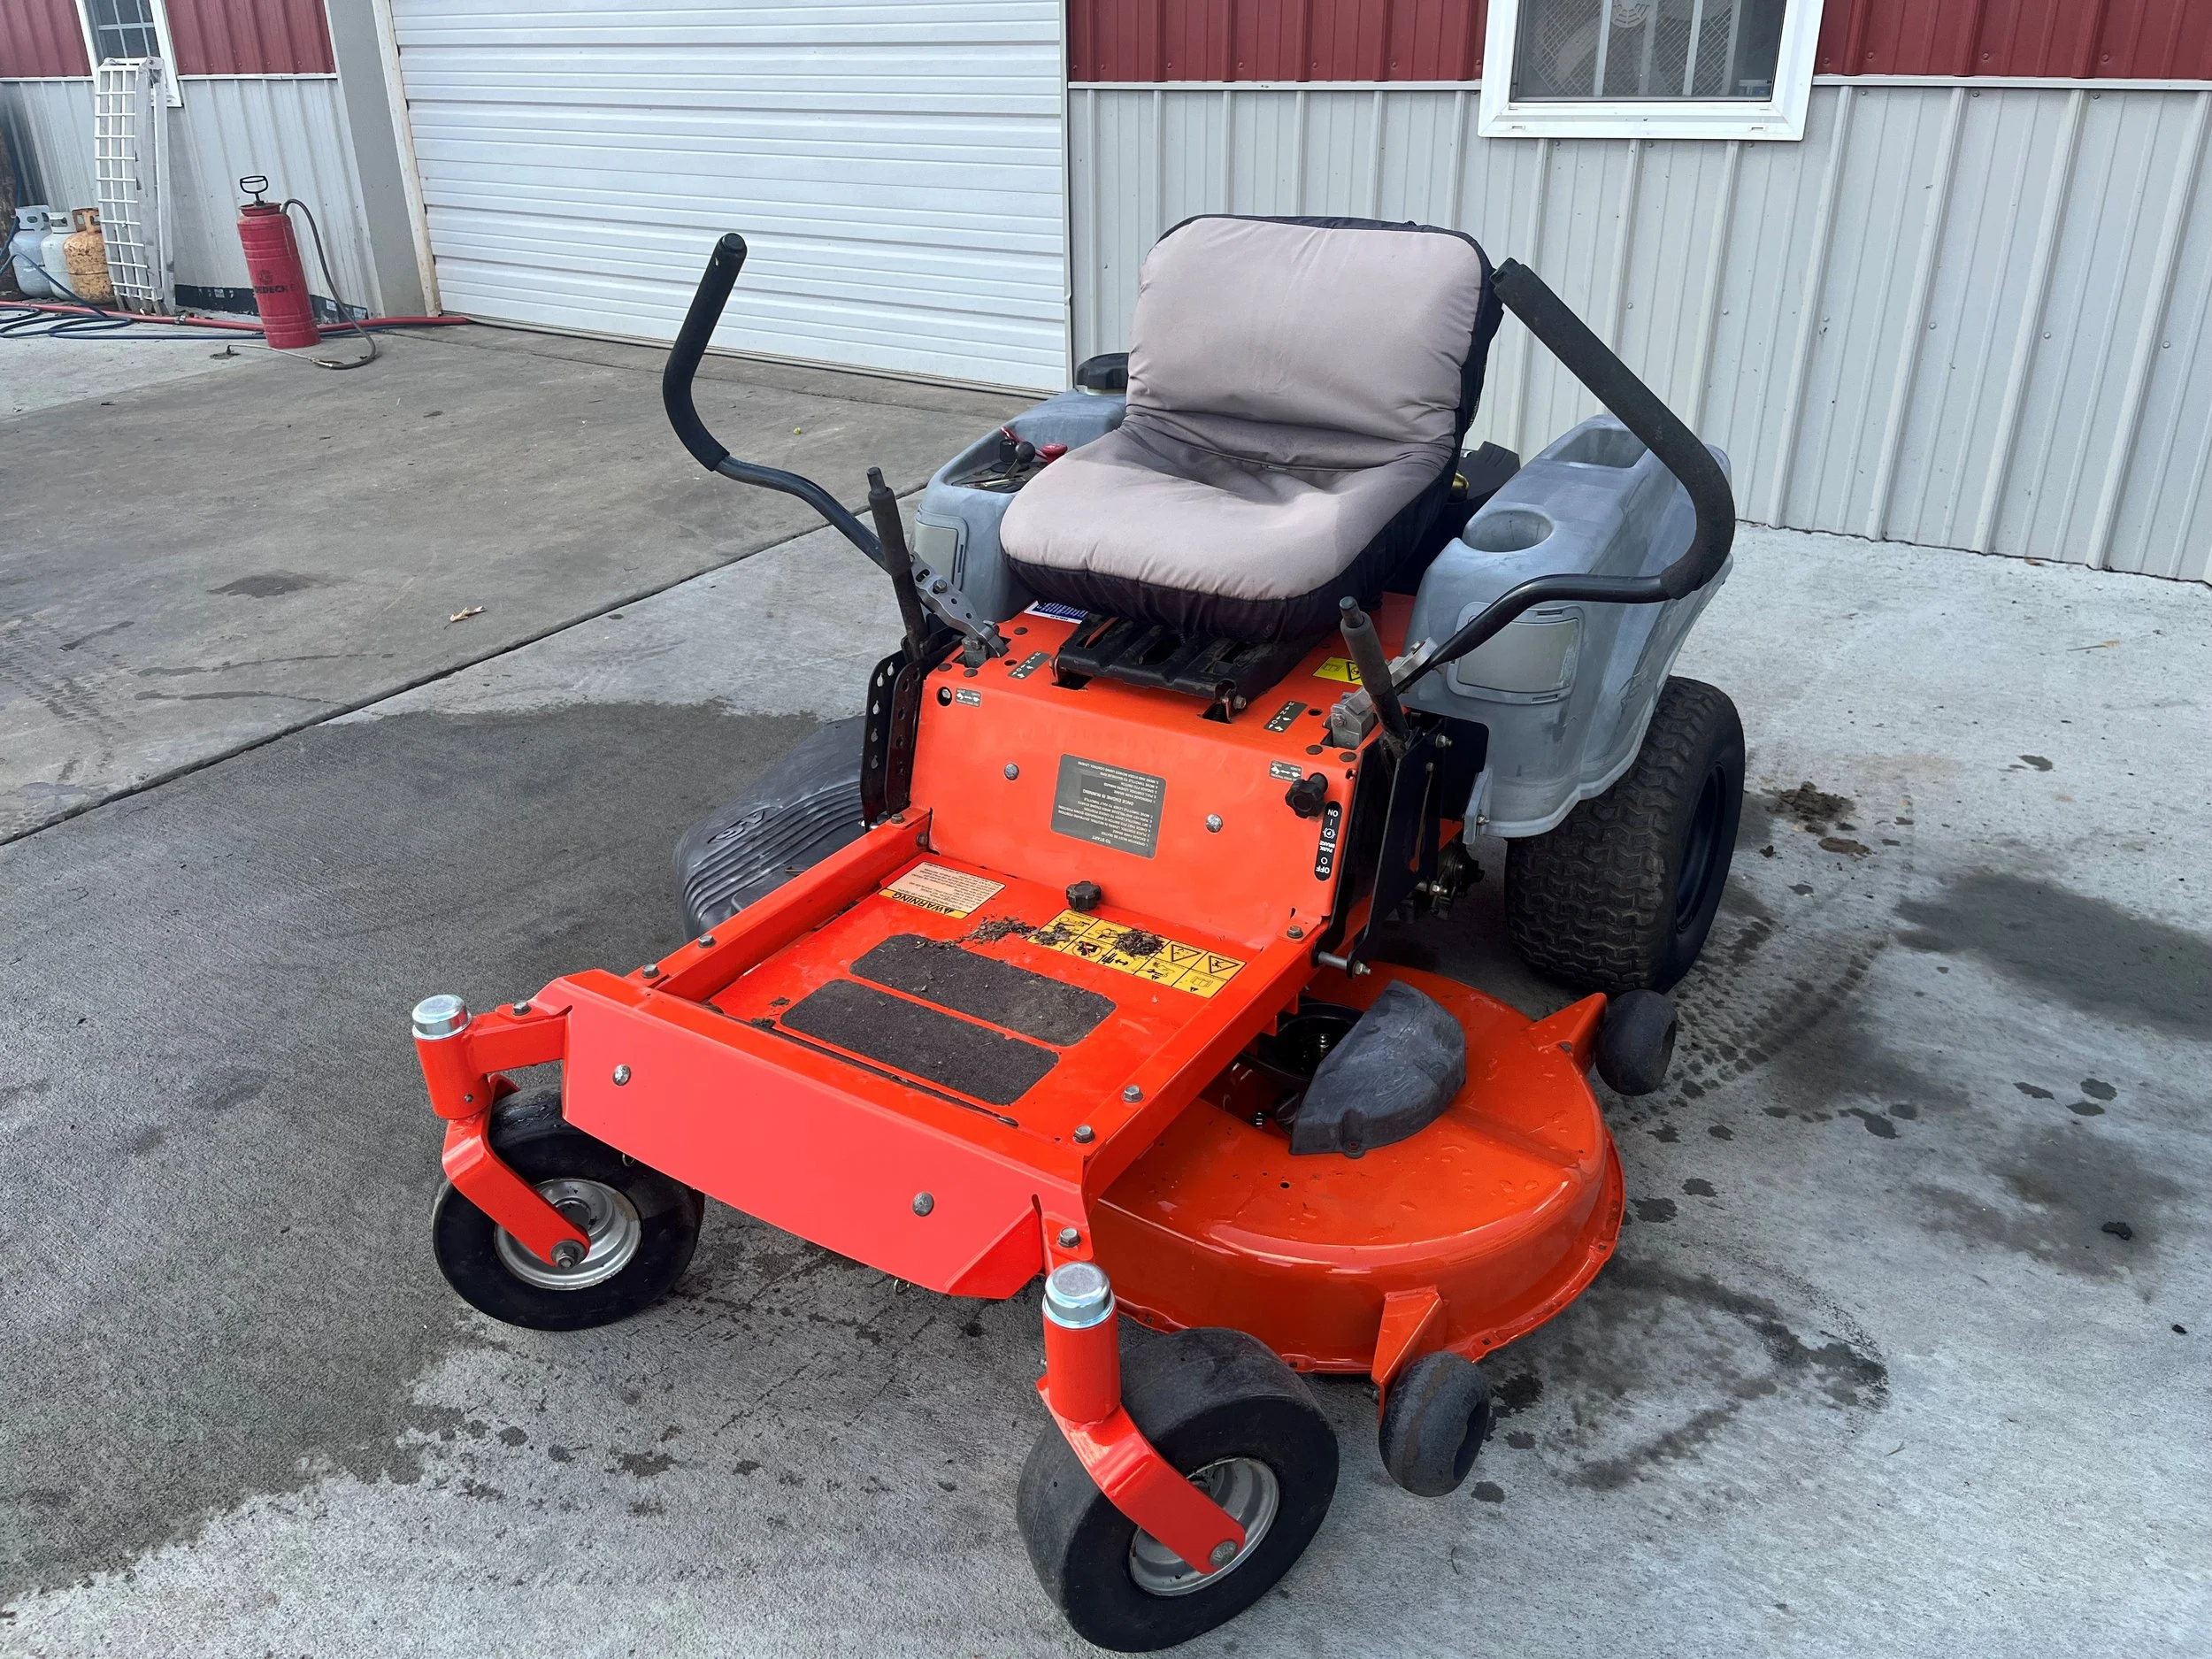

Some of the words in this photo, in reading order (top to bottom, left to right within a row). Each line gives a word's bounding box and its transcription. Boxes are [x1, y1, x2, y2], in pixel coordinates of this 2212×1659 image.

[1319, 840, 1335, 849] BRAKE
[1316, 865, 1330, 874] OFF
[892, 892, 944, 913] WARNING
